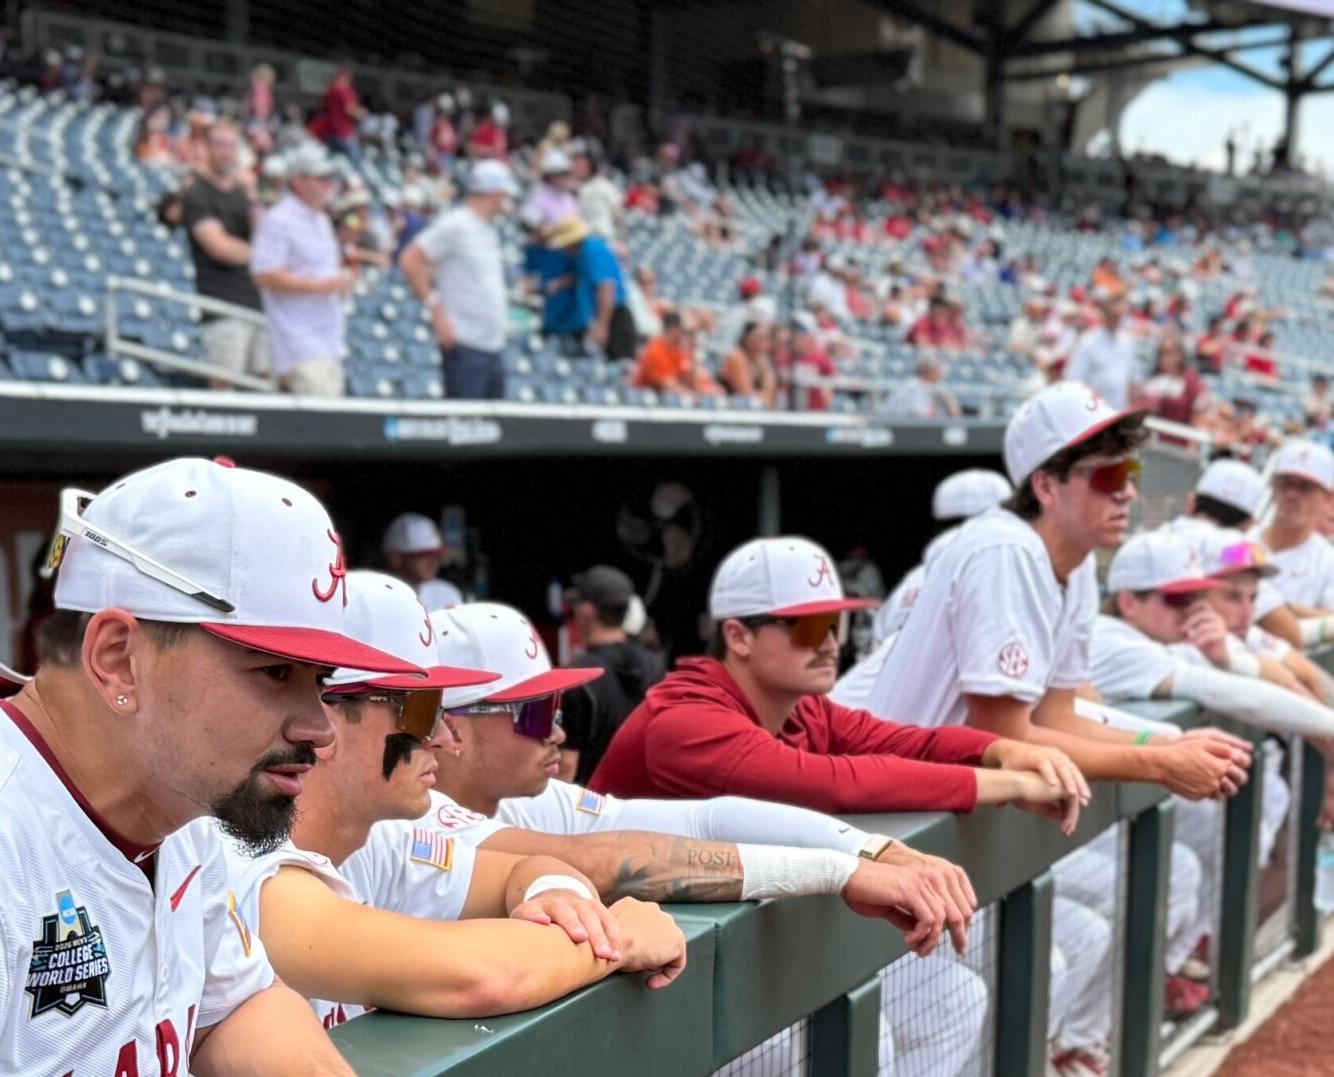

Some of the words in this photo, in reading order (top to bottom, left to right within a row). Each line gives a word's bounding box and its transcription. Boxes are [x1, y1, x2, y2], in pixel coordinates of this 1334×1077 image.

[687, 849, 732, 867] POSI
[48, 944, 94, 969] COLLEGE
[26, 966, 74, 988] WORLD
[74, 957, 108, 981] SERIES
